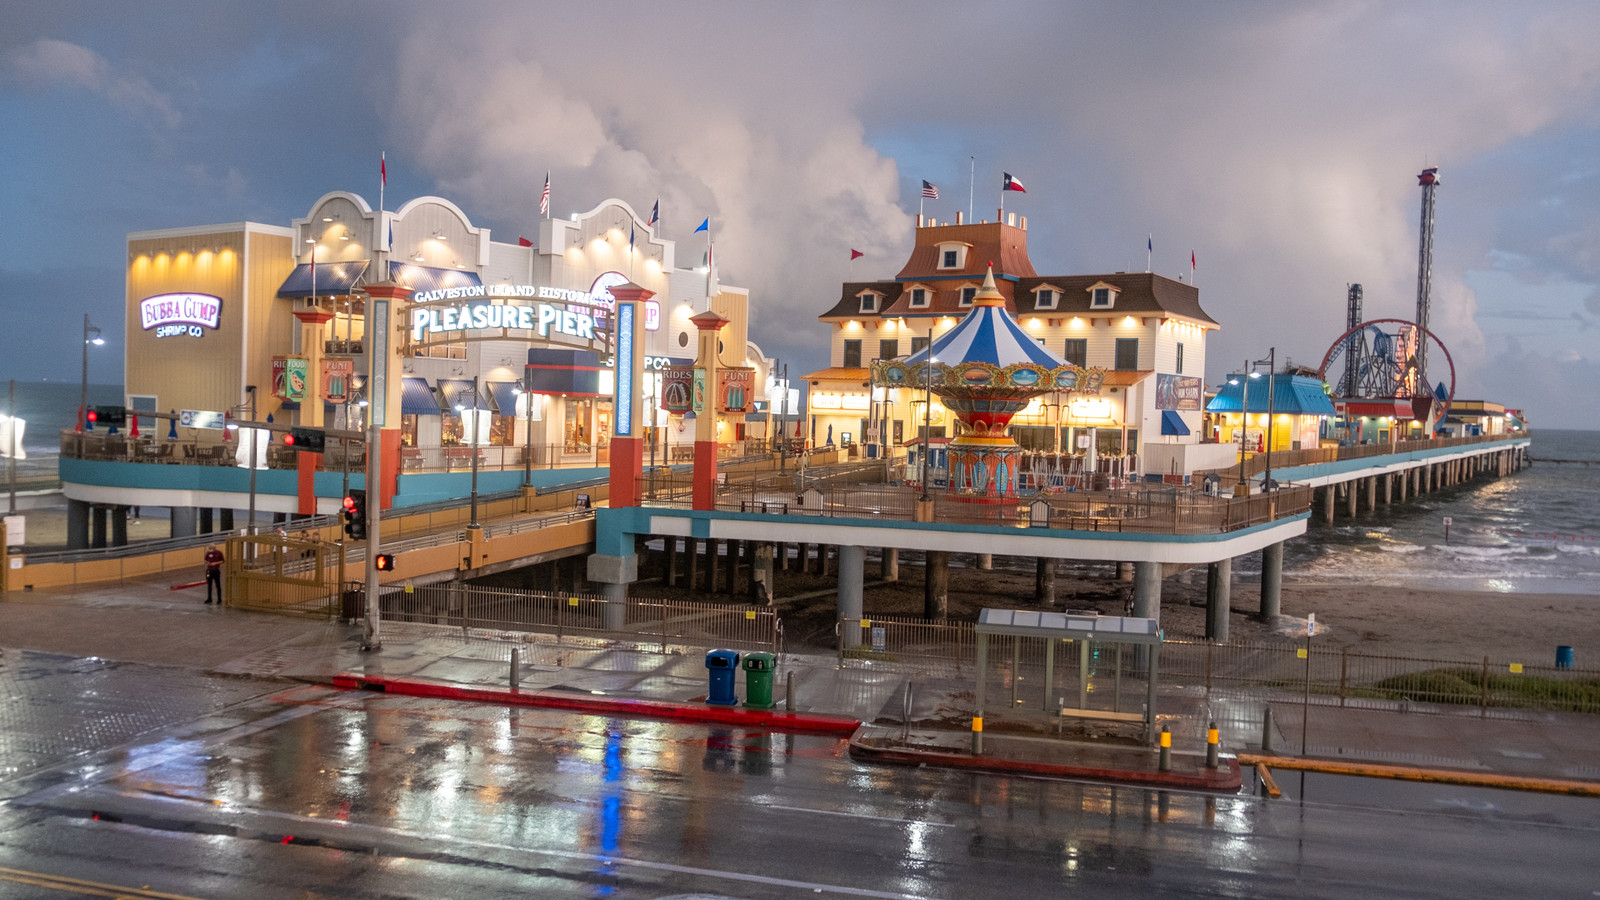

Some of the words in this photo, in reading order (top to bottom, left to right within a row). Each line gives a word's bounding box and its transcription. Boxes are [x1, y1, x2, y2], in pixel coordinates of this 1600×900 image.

[414, 285, 486, 303] GALVESTON
[489, 285, 535, 297] ISLAND
[145, 301, 181, 323] BUBBA
[184, 296, 217, 322] GUMP
[413, 305, 535, 341] PLEASURE
[538, 303, 595, 340] PIER
[156, 325, 187, 338] SHRIMP
[664, 371, 692, 379] RIDES
[725, 372, 748, 380] FUN!
